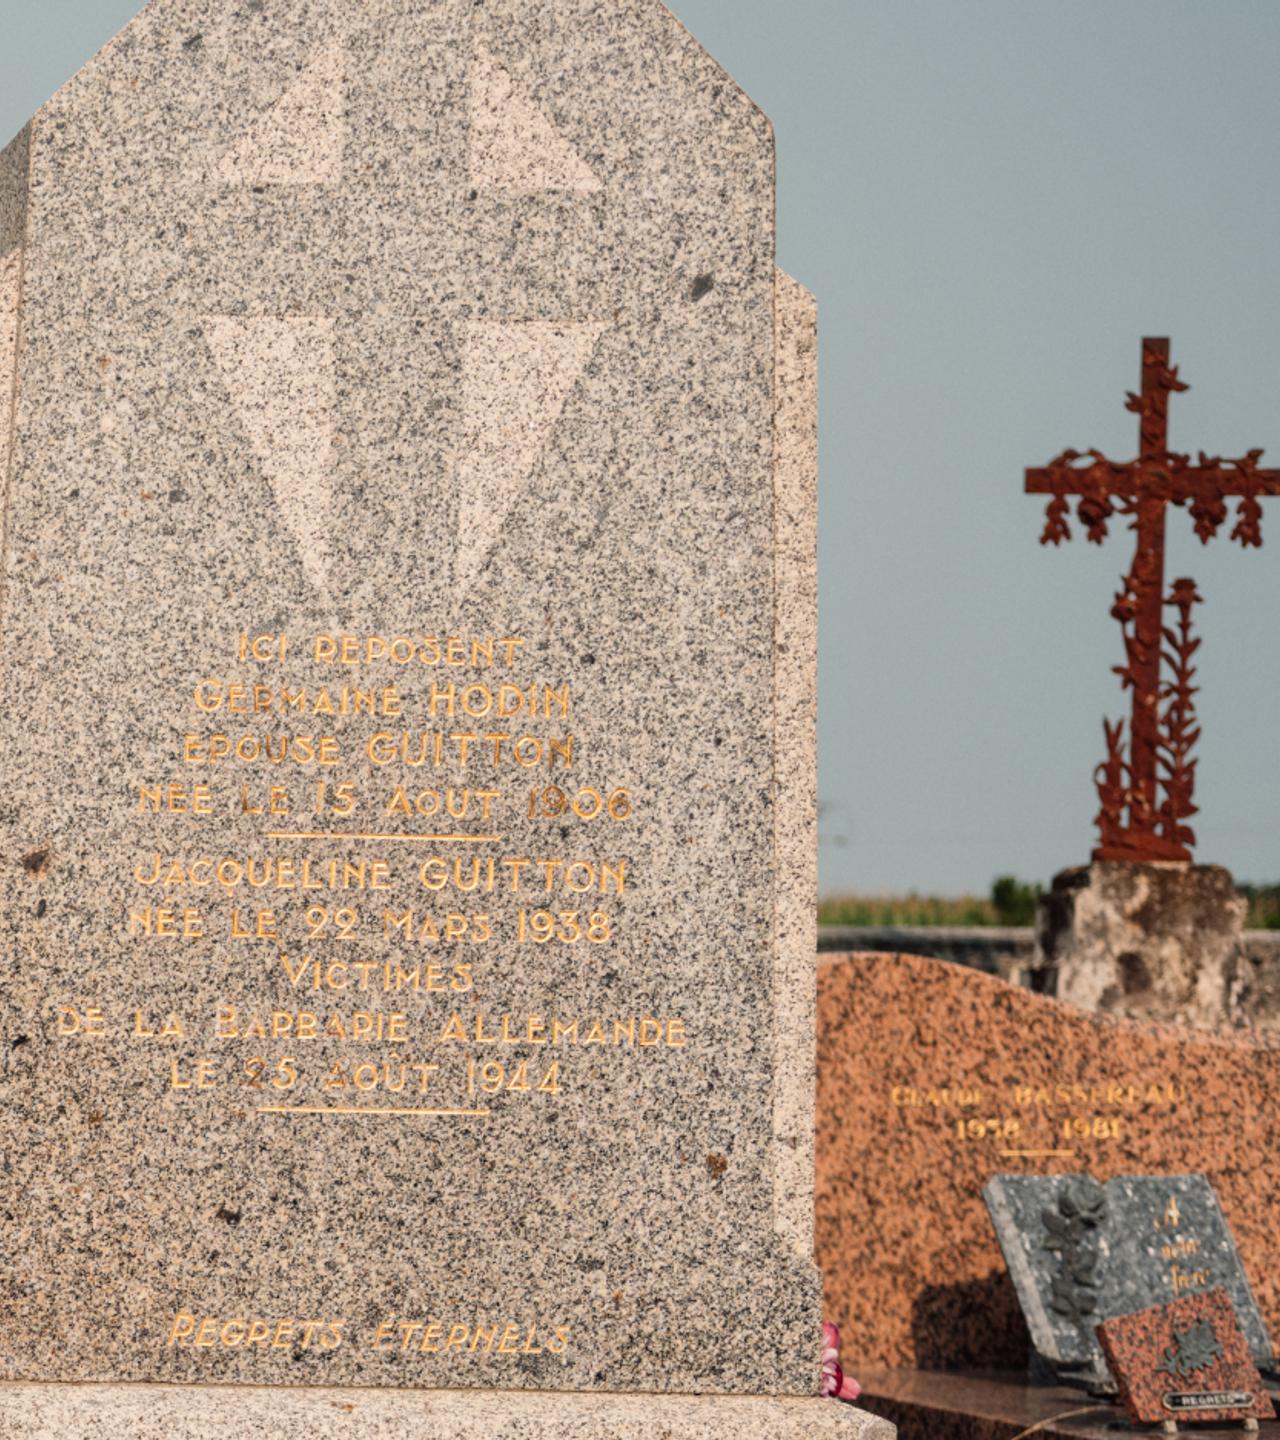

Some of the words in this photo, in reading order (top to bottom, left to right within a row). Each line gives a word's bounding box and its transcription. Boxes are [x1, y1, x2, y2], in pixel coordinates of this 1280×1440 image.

[241, 635, 285, 662] ICI
[315, 635, 524, 666] REPOSENT
[194, 679, 401, 715] GERMAINE
[430, 683, 569, 720] HODIN
[368, 732, 574, 768] GUITTON
[241, 783, 289, 815] LE
[316, 782, 353, 817] 15
[528, 785, 632, 821] 1906
[134, 854, 391, 897] JACQUELINE
[420, 857, 624, 894] GUITTON
[231, 908, 276, 938] LE
[305, 907, 357, 941] 22
[384, 909, 492, 943] MARS
[517, 909, 611, 944] 1938
[280, 955, 474, 993] VICTIMES
[58, 1007, 105, 1037] DE
[135, 1008, 183, 1038] LA
[218, 1006, 408, 1042] BARBARIE
[442, 1011, 687, 1047] ALLEMANDE
[171, 1058, 216, 1089] LE
[243, 1056, 297, 1089] 25
[466, 1053, 561, 1095] 1944
[168, 1313, 343, 1349] REGRETS
[374, 1312, 572, 1355] ÉTERNELS
